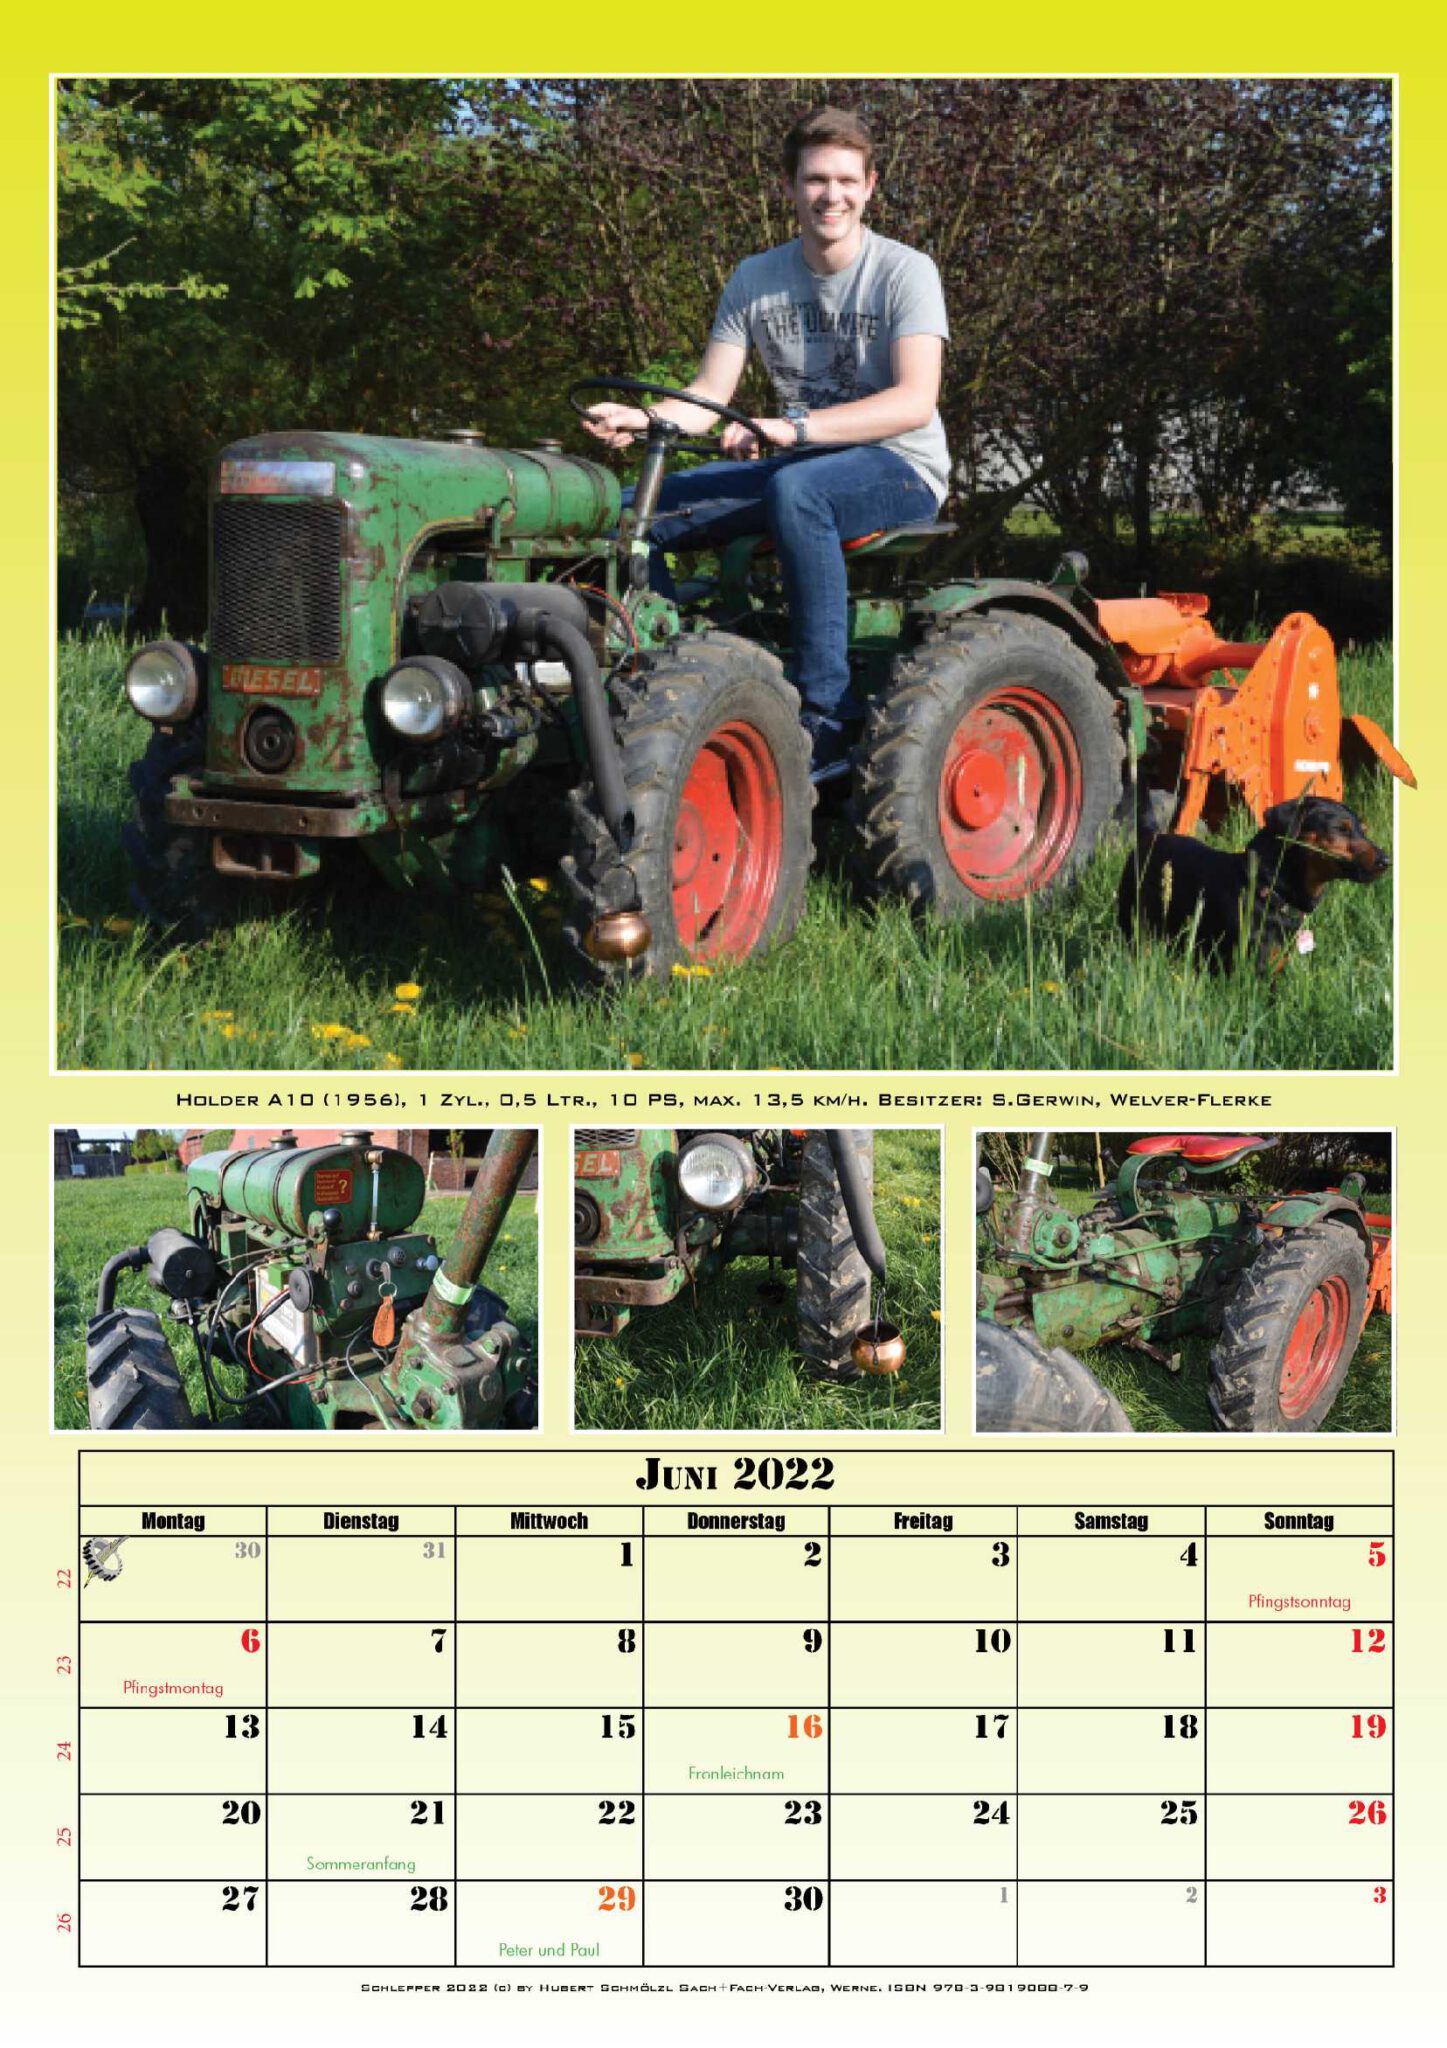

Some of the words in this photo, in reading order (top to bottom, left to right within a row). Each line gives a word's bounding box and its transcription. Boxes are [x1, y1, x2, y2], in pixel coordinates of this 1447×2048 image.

[229, 667, 313, 692] DIESEL
[323, 1092, 407, 1109] (1956),
[418, 1093, 428, 1107] 1
[499, 1092, 537, 1109] 0,5
[610, 1092, 637, 1107] 10
[753, 1092, 804, 1109] 13,5
[733, 1456, 836, 1491] 2022
[141, 1511, 206, 1533] Montag
[323, 1511, 400, 1533] Dienstag
[510, 1511, 589, 1530] Mittwoch
[687, 1511, 786, 1533] Donnerstag
[894, 1511, 954, 1533] Freitag
[1074, 1511, 1149, 1533] Samstag
[1263, 1511, 1335, 1533] Sonntag
[235, 1541, 262, 1559] 30
[422, 1541, 445, 1559] 31
[620, 1541, 634, 1568] 1
[803, 1541, 823, 1568] 2
[991, 1541, 1011, 1568] 3
[1179, 1541, 1199, 1568] 4
[1367, 1540, 1387, 1568] 5
[56, 1568, 72, 1589] 22
[1248, 1593, 1352, 1612] Pfingstsonntag
[240, 1628, 262, 1654] 6
[430, 1627, 448, 1654] 7
[616, 1627, 637, 1654] 8
[802, 1627, 823, 1654] 9
[975, 1627, 1012, 1654] 10
[1163, 1628, 1197, 1654] 11
[1351, 1628, 1386, 1654] 12
[56, 1655, 72, 1675] 23
[123, 1679, 224, 1699] Pfingstmontag
[224, 1713, 261, 1740] 13
[412, 1714, 449, 1739] 14
[601, 1713, 636, 1740] 15
[787, 1713, 824, 1740] 16
[975, 1713, 1010, 1740] 17
[1163, 1713, 1199, 1740] 18
[1351, 1713, 1387, 1740] 19
[56, 1741, 72, 1762] 24
[688, 1764, 785, 1780] Fronleichnam
[221, 1799, 262, 1826] 20
[409, 1799, 445, 1826] 21
[597, 1799, 636, 1826] 22
[783, 1799, 823, 1826] 23
[972, 1799, 1011, 1826] 24
[1160, 1799, 1198, 1826] 25
[1348, 1799, 1388, 1826] 26
[56, 1826, 72, 1847] 25
[306, 1855, 416, 1875] Sommeranfang
[221, 1885, 260, 1912] 27
[409, 1885, 449, 1912] 28
[597, 1884, 637, 1912] 29
[783, 1885, 824, 1912] 30
[999, 1886, 1010, 1904] 1
[1185, 1886, 1198, 1904] 2
[1372, 1885, 1387, 1904] 3
[56, 1912, 72, 1934] 26
[499, 1942, 534, 1957] Peter
[538, 1941, 566, 1958] und
[570, 1942, 600, 1957] Paul
[445, 1983, 488, 1993] 2022
[887, 1983, 927, 1993] ISBN
